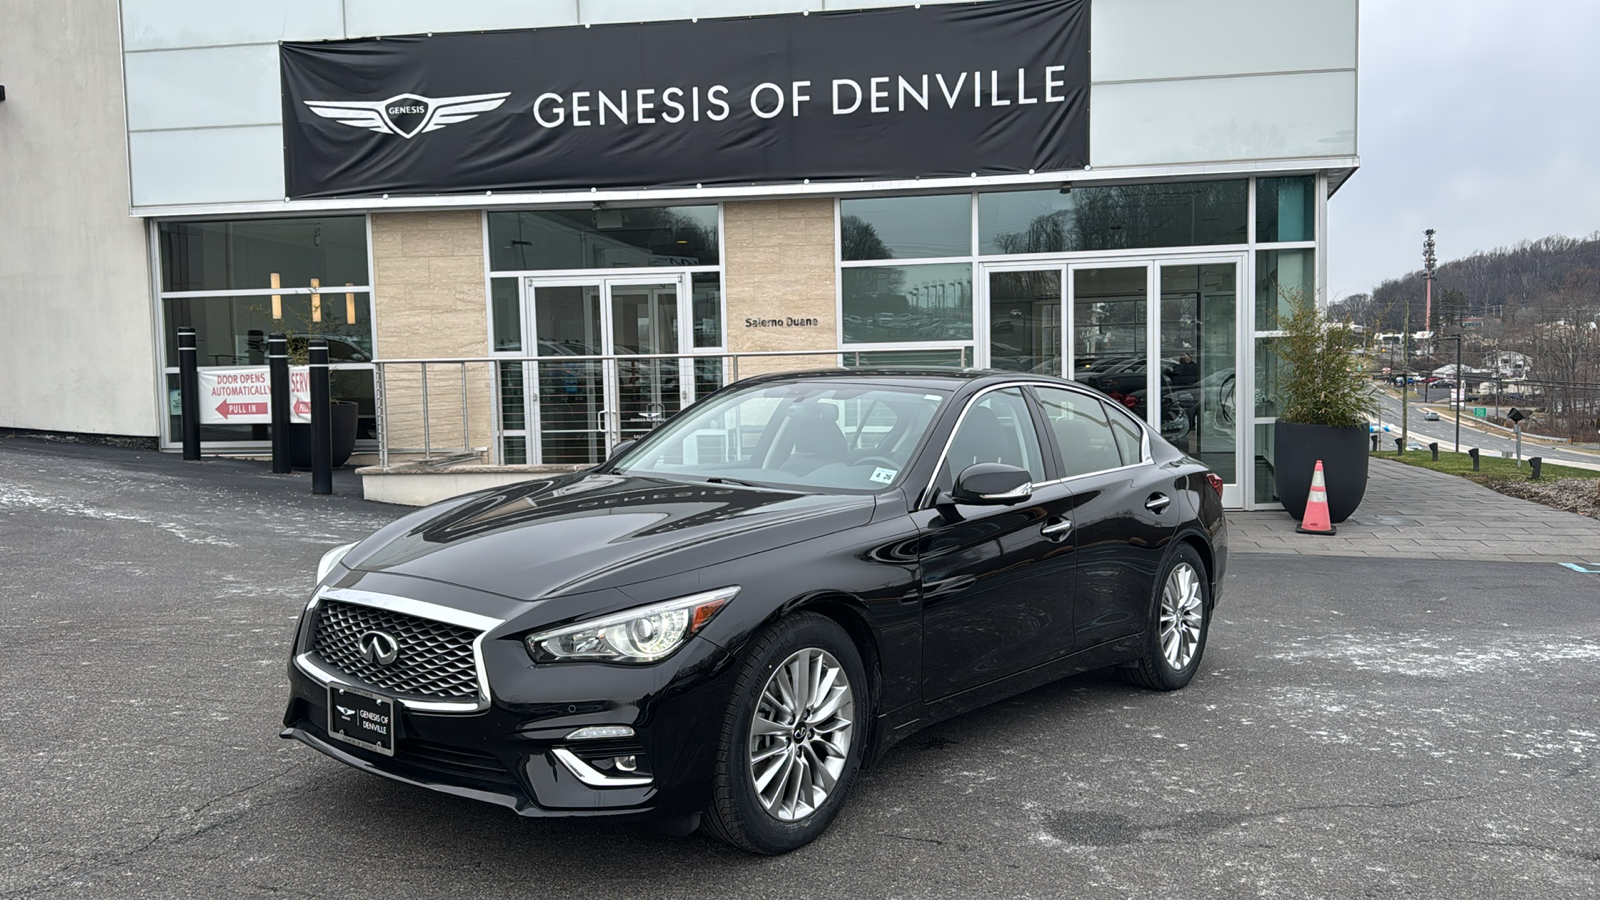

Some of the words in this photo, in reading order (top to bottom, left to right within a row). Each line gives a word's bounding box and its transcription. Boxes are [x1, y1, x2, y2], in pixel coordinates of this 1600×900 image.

[532, 84, 730, 129] GENESIS
[750, 80, 811, 119] OF
[832, 64, 1065, 115] DENVILLE
[388, 104, 426, 116] GENESIS
[745, 318, 784, 328] Salerno
[786, 317, 818, 327] Duane
[217, 373, 238, 385] DOOR
[239, 373, 266, 383] OPENS
[229, 404, 246, 414] PULL
[248, 404, 257, 413] IN
[360, 709, 381, 722] GENESIS
[380, 716, 389, 725] OF
[363, 721, 388, 735] DENVILLE
